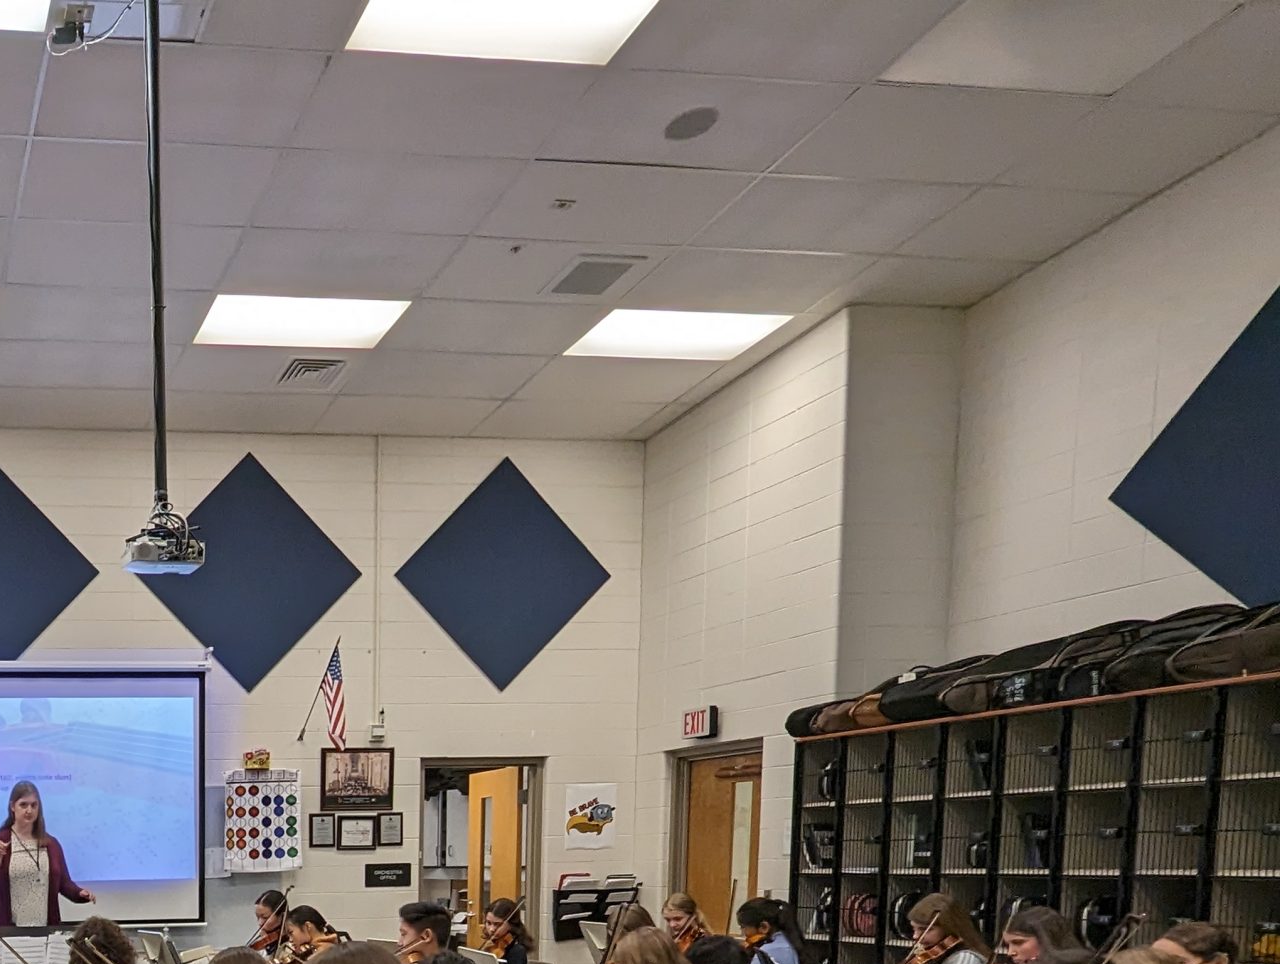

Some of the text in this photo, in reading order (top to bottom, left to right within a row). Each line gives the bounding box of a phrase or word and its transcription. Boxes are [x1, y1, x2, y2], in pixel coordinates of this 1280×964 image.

[684, 710, 706, 735] EXIT
[568, 797, 599, 817] BE BRAVE
